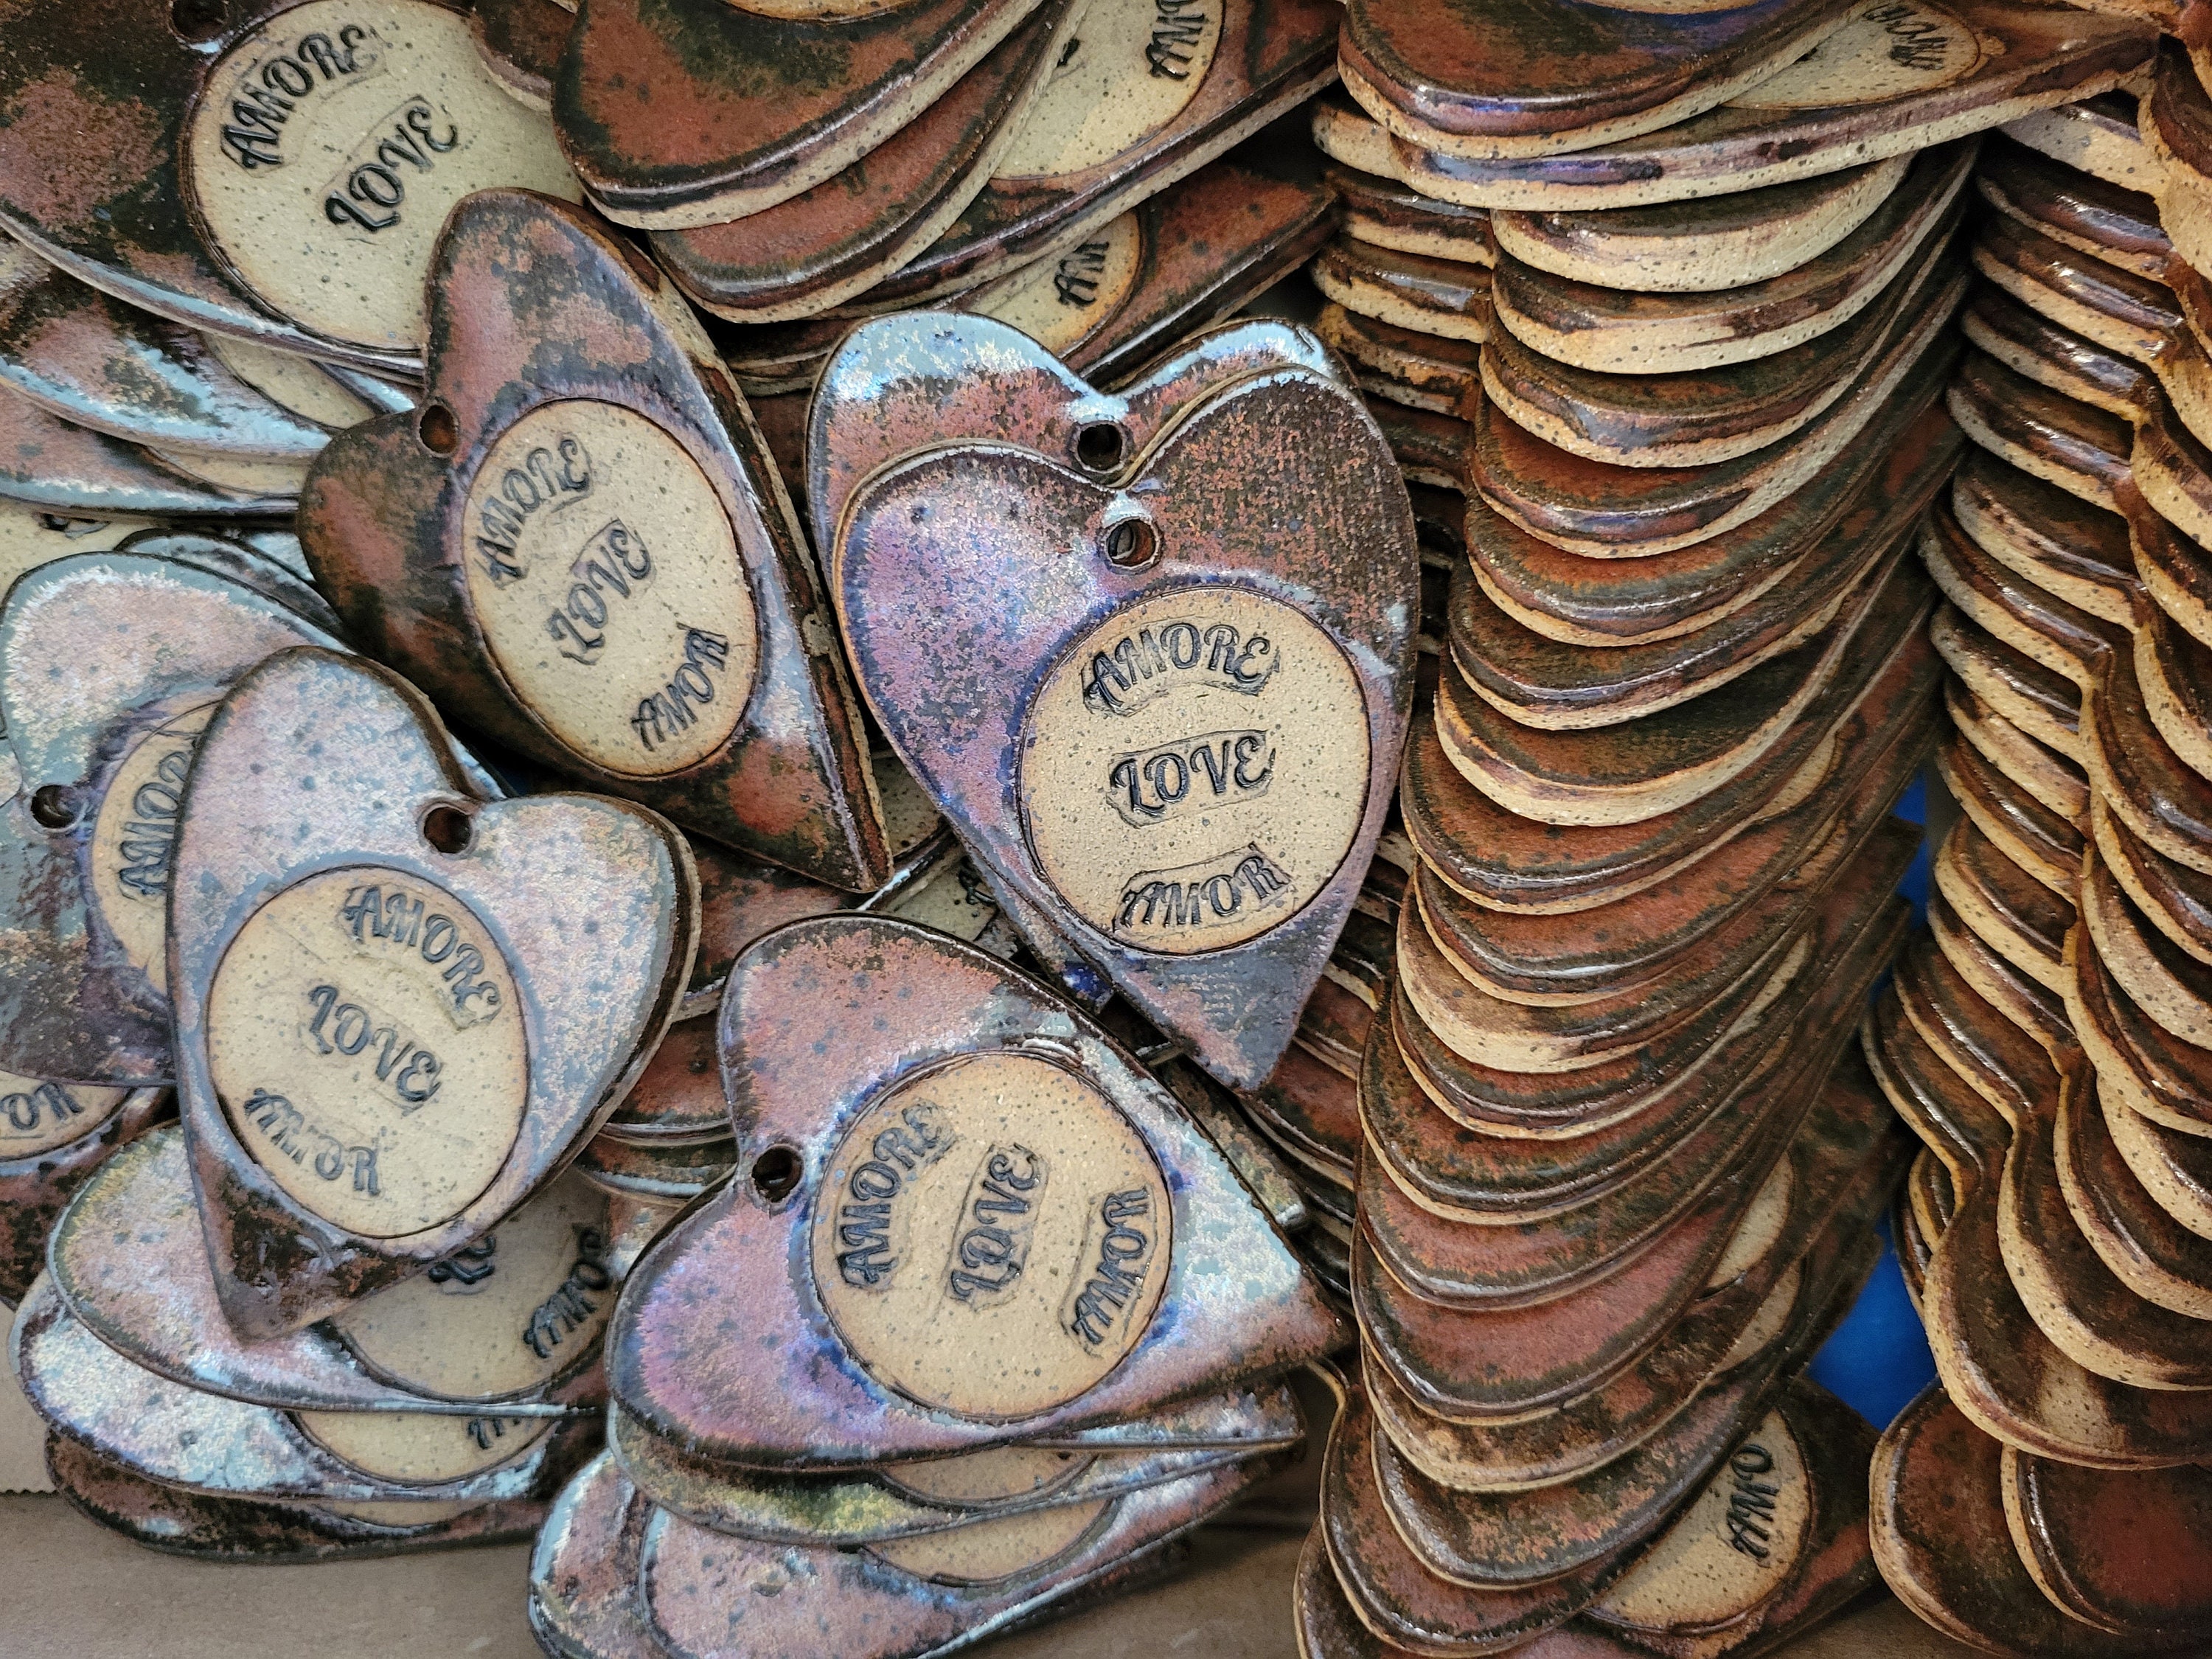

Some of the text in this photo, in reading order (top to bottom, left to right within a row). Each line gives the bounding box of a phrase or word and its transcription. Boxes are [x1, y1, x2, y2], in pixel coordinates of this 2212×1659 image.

[221, 24, 367, 170] AMORE
[324, 105, 458, 233] LOVE
[475, 438, 591, 582] AMORE
[546, 528, 652, 648] LOVE
[631, 628, 729, 752] AMOR
[1083, 622, 1271, 709] AMORE
[1110, 736, 1276, 816] LOVE
[343, 886, 501, 1023] AMORE
[1121, 855, 1287, 928] AMOR
[308, 984, 441, 1102] LOVE
[244, 1088, 380, 1196] AMOR
[835, 1099, 956, 1284] AMORE
[951, 1144, 1040, 1299] LOVE
[1072, 1186, 1149, 1344] AMOR
